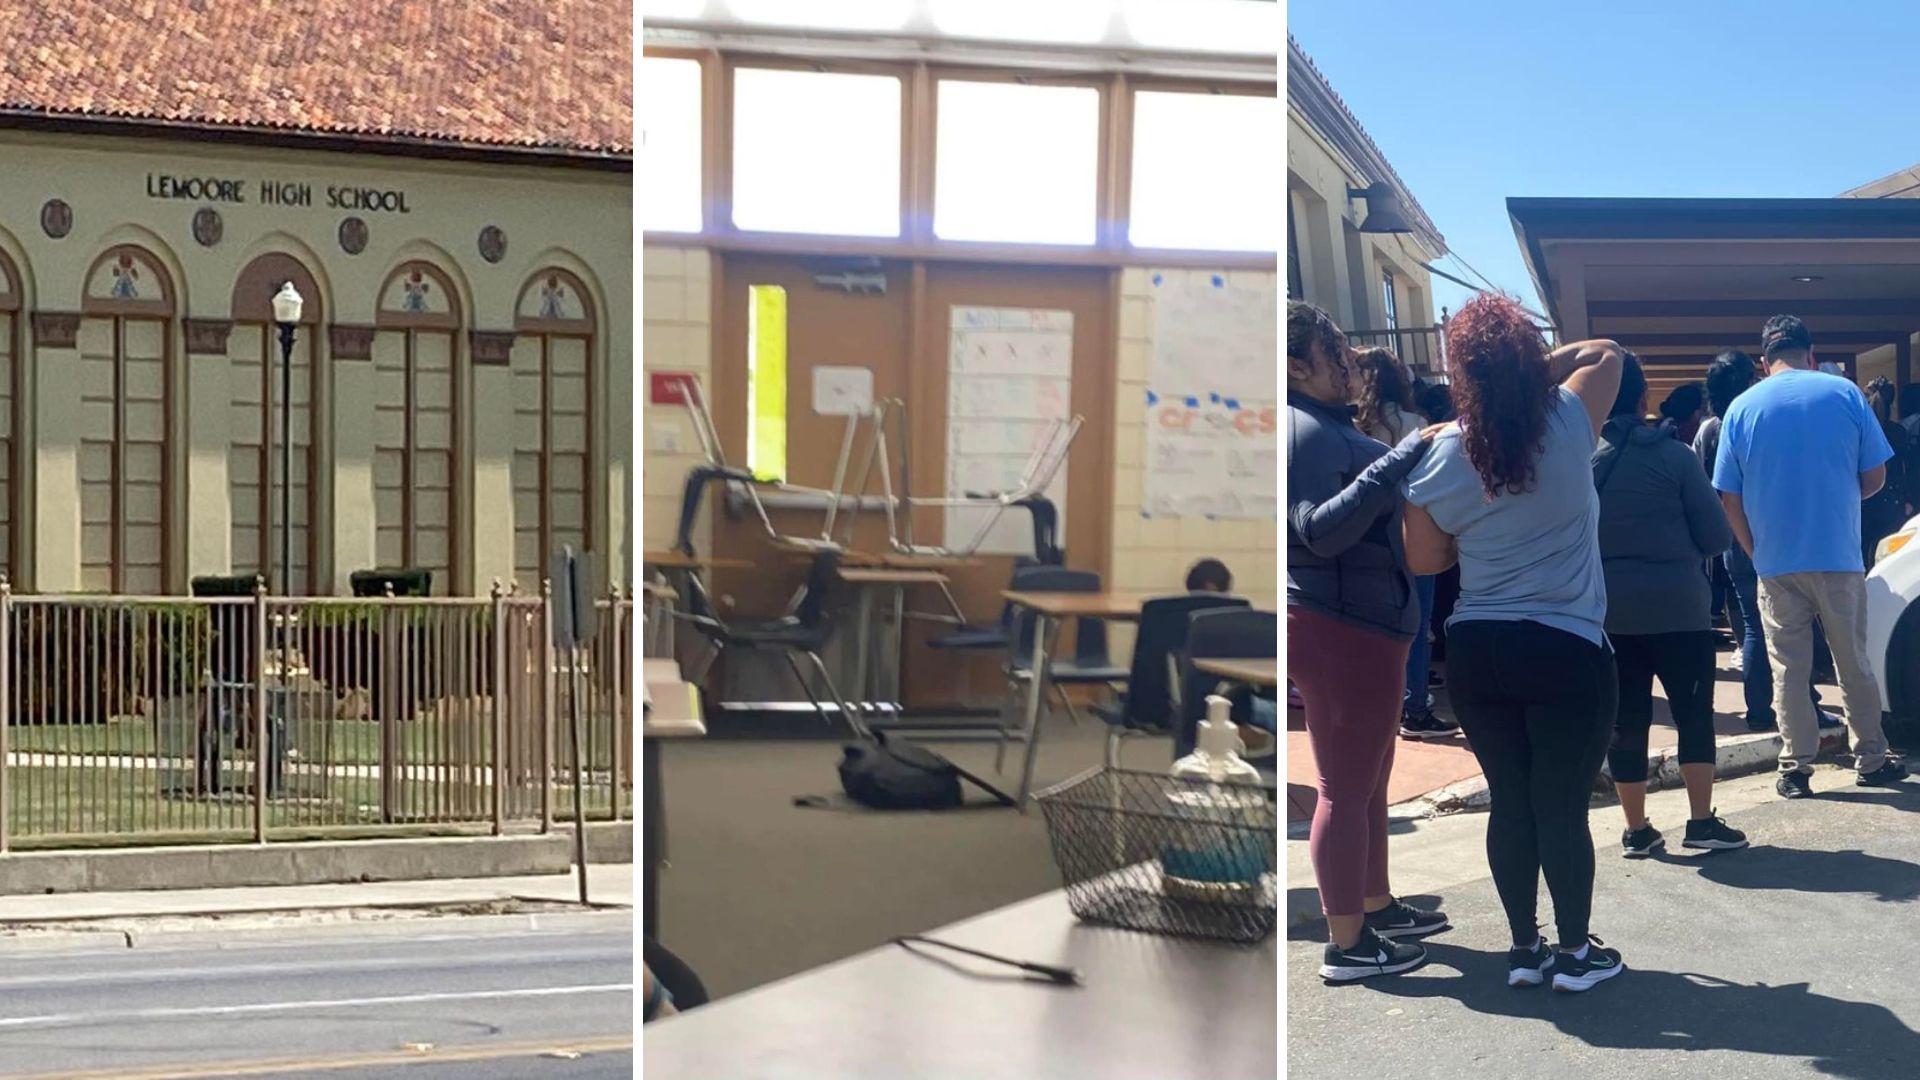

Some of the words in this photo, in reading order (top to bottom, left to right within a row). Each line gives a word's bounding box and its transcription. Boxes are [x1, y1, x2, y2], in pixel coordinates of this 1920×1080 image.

[147, 173, 244, 202] LEMOORE
[260, 180, 311, 206] HIGH
[327, 186, 410, 213] SCHOOL
